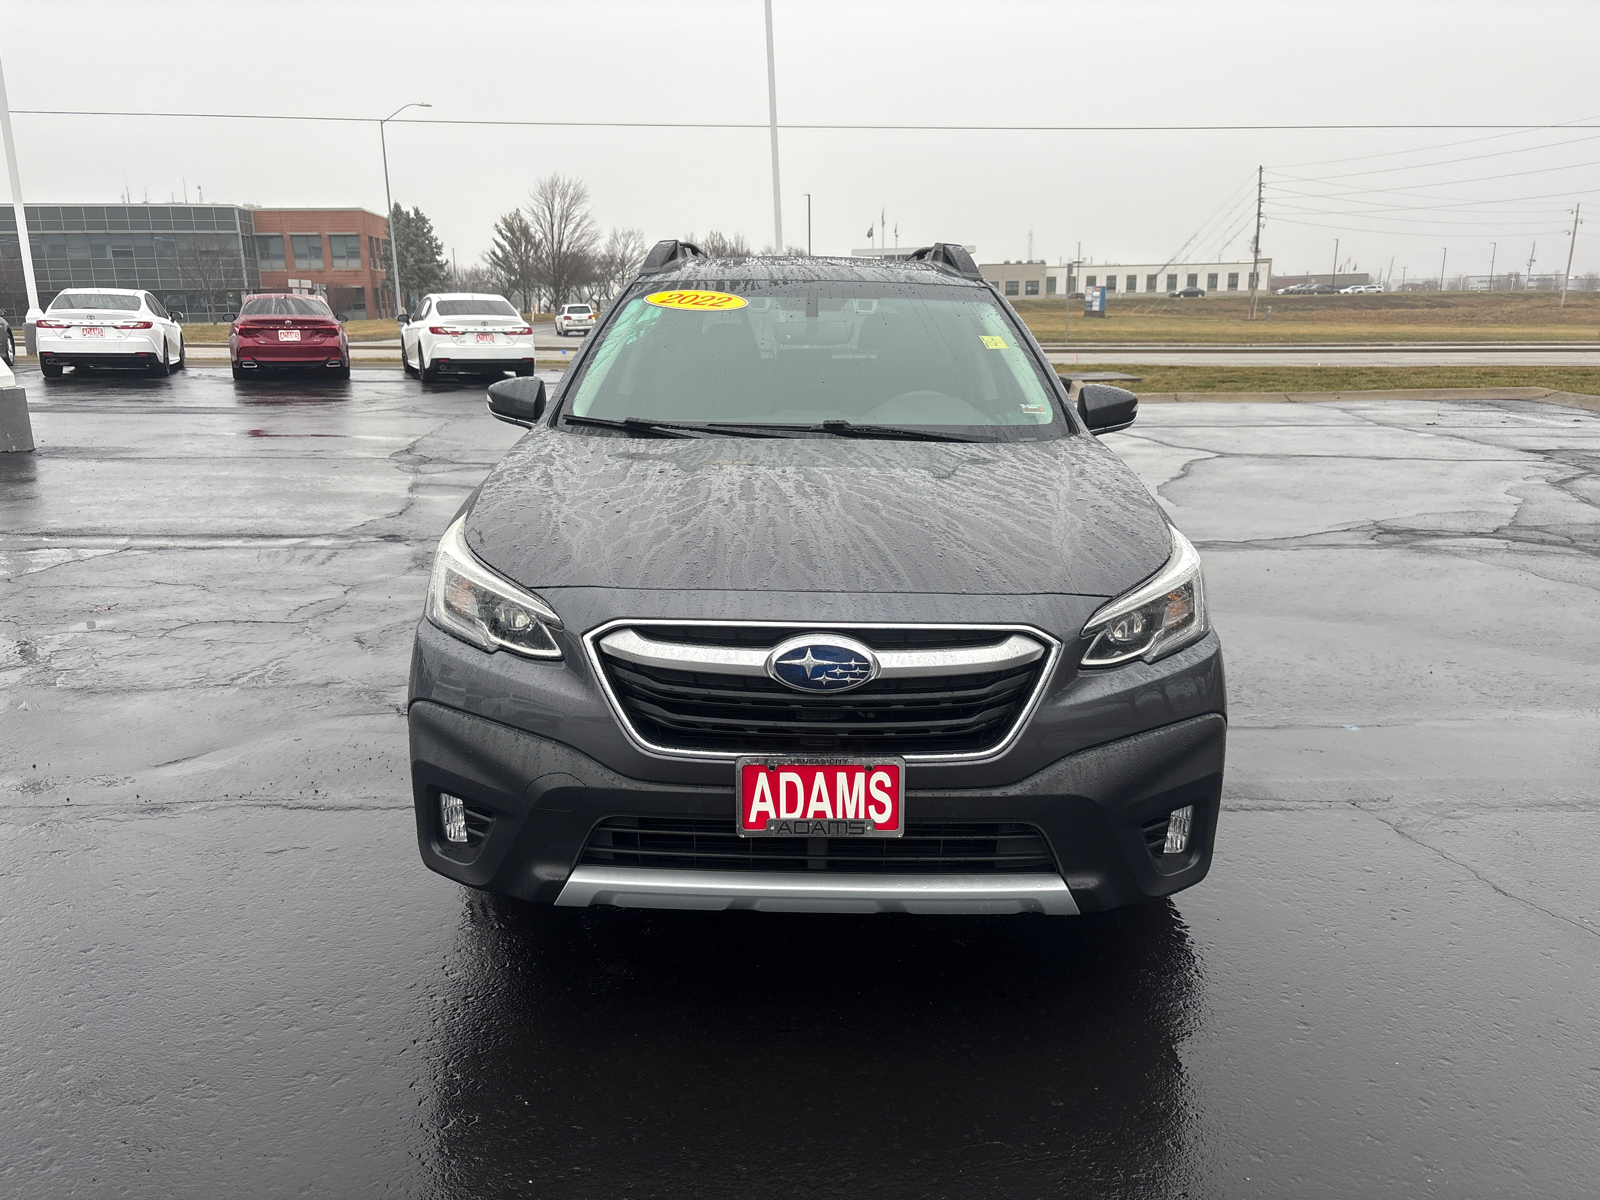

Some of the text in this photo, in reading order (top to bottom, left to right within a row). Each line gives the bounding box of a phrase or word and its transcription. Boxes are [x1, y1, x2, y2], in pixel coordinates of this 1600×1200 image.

[658, 293, 733, 308] 2022
[82, 327, 104, 337] ADAMS
[280, 331, 300, 340] ADAMS
[476, 333, 495, 341] ADAMS
[748, 771, 893, 824] ADAMS
[776, 820, 866, 835] ADAMS
